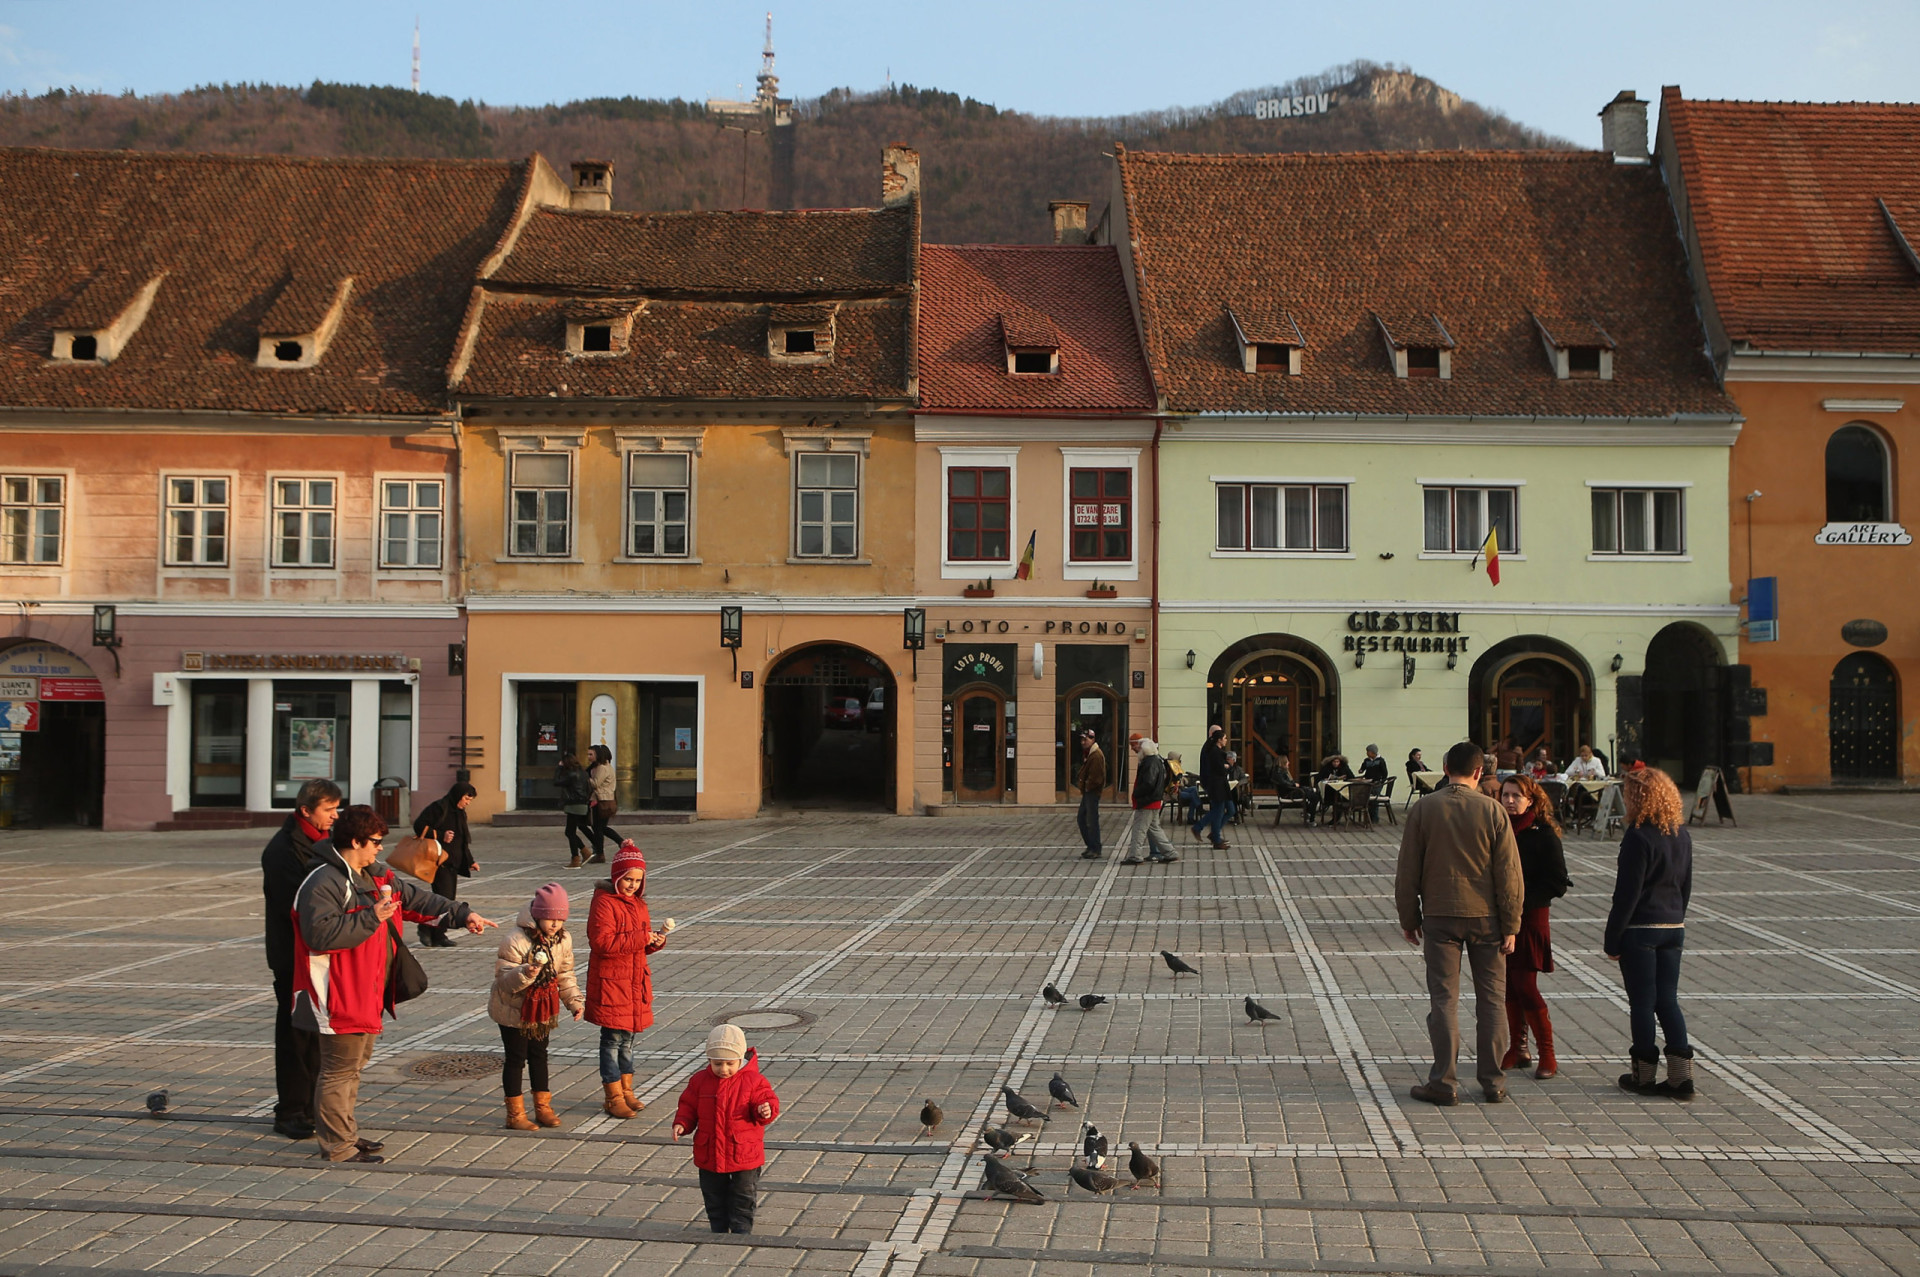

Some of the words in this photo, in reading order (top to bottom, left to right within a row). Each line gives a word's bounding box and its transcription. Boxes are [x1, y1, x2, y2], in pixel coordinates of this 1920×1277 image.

[1256, 93, 1329, 120] BRASOV
[1077, 506, 1085, 514] DE
[1849, 524, 1879, 533] ART
[1826, 532, 1903, 543] GALLERY
[946, 620, 1009, 633] LOTO
[1045, 621, 1126, 634] PRONO
[1347, 611, 1461, 632] GUSTARI
[1343, 635, 1470, 652] RESTAURANT
[210, 655, 265, 668] INTESA
[353, 655, 396, 669] BANK
[953, 653, 975, 671] LOTO
[979, 652, 1004, 672] PRONO
